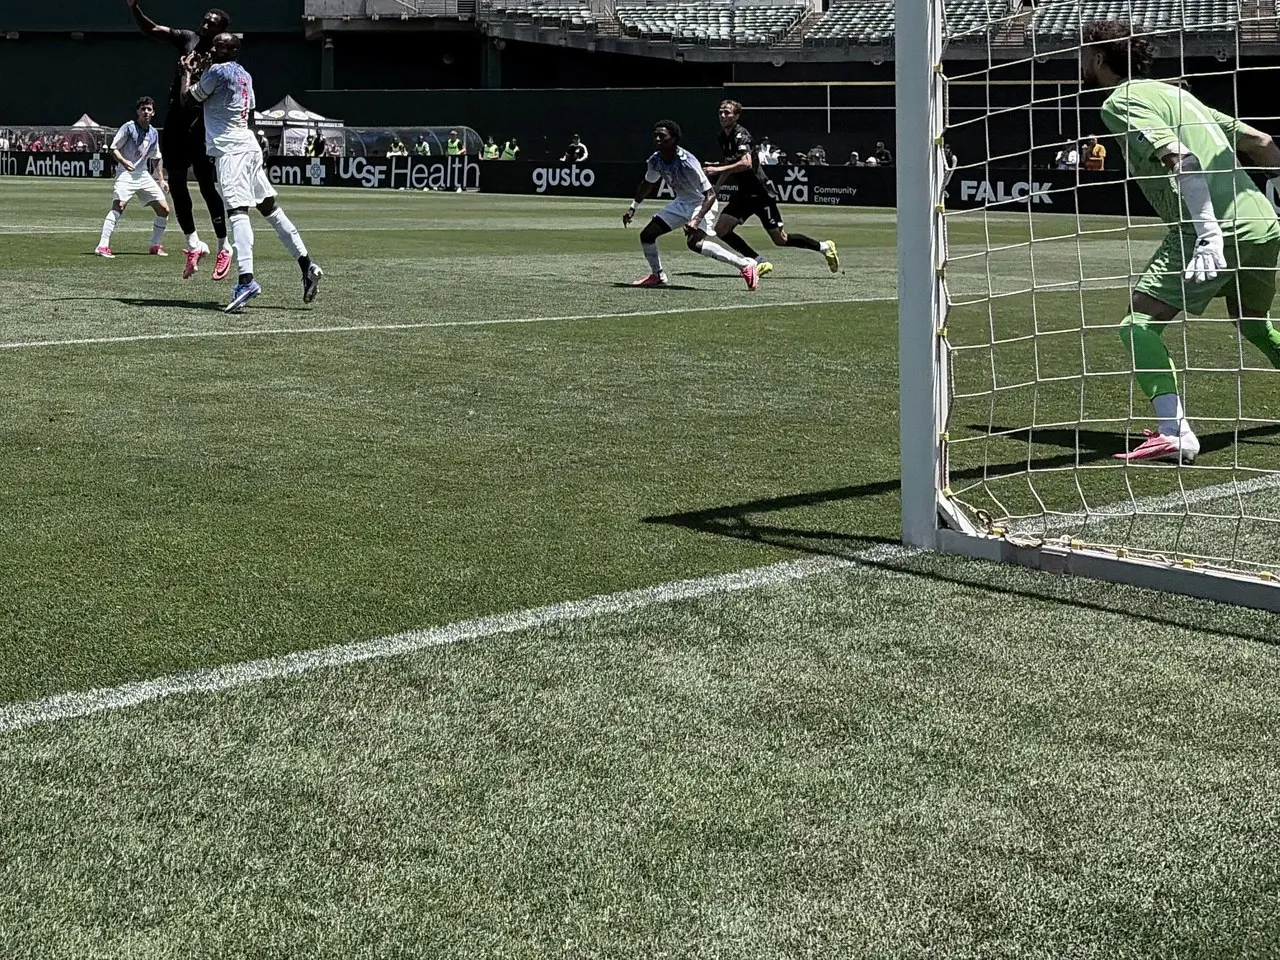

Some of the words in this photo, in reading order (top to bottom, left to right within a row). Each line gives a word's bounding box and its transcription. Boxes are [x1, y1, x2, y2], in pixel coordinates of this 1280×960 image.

[25, 155, 86, 177] Anthem
[339, 156, 387, 188] UCSF
[390, 155, 481, 189] Health
[532, 166, 595, 193] gusto
[813, 185, 857, 197] Community
[813, 195, 841, 205] Energy
[960, 179, 1053, 204] FALCK
